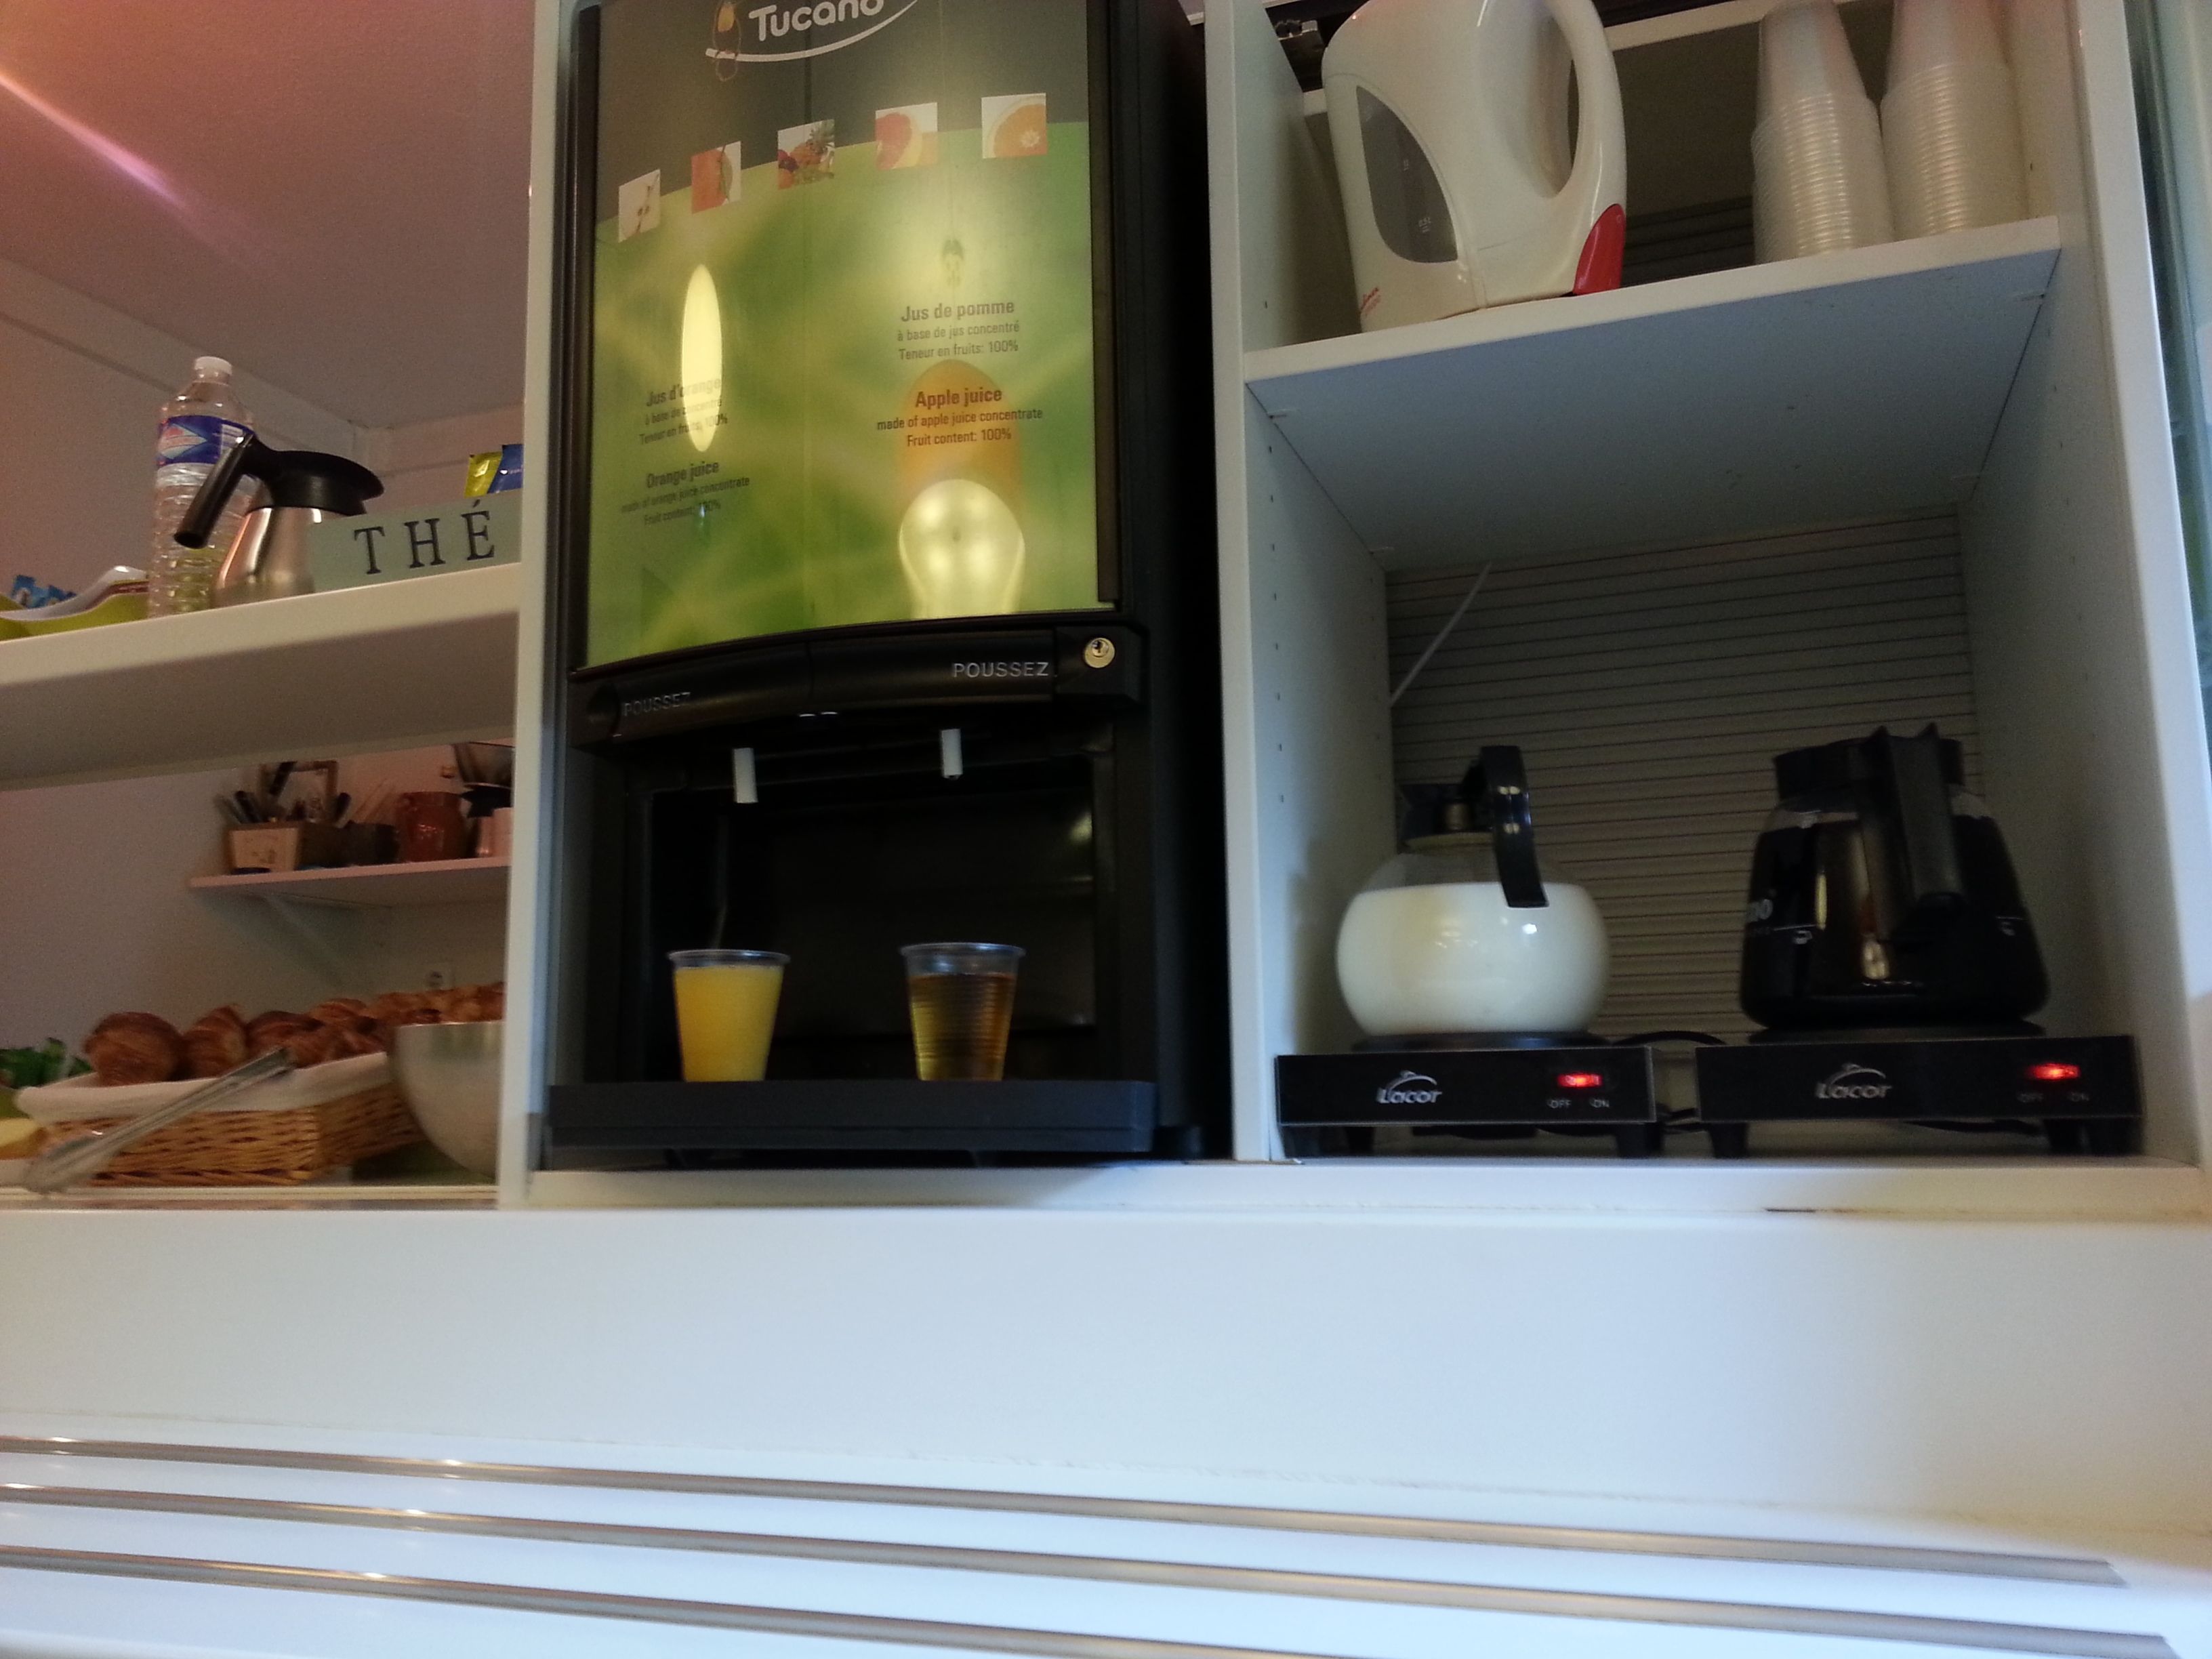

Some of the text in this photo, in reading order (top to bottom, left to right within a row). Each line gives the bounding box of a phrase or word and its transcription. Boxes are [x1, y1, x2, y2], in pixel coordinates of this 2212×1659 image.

[748, 0, 884, 41] Tucano
[901, 302, 1015, 322] Jus de pomme
[907, 327, 930, 341] base
[934, 326, 946, 338] de
[949, 325, 964, 339] jus
[968, 320, 1020, 335] concentré
[899, 340, 1018, 360] Teneur en fruits: 100%
[916, 387, 1002, 410] Apple juice
[877, 409, 1043, 430] made of apple juice concentrate
[907, 428, 1011, 447] Fruit content: 100%
[647, 461, 720, 489] Orange juice
[354, 499, 495, 575] THÉ
[953, 662, 1049, 678] POUSSEZ
[623, 691, 691, 716] POUSSEZ
[1376, 1087, 1442, 1104] Lacor
[1815, 1082, 1891, 1099] Lacor
[1548, 1099, 1572, 1109] OFF
